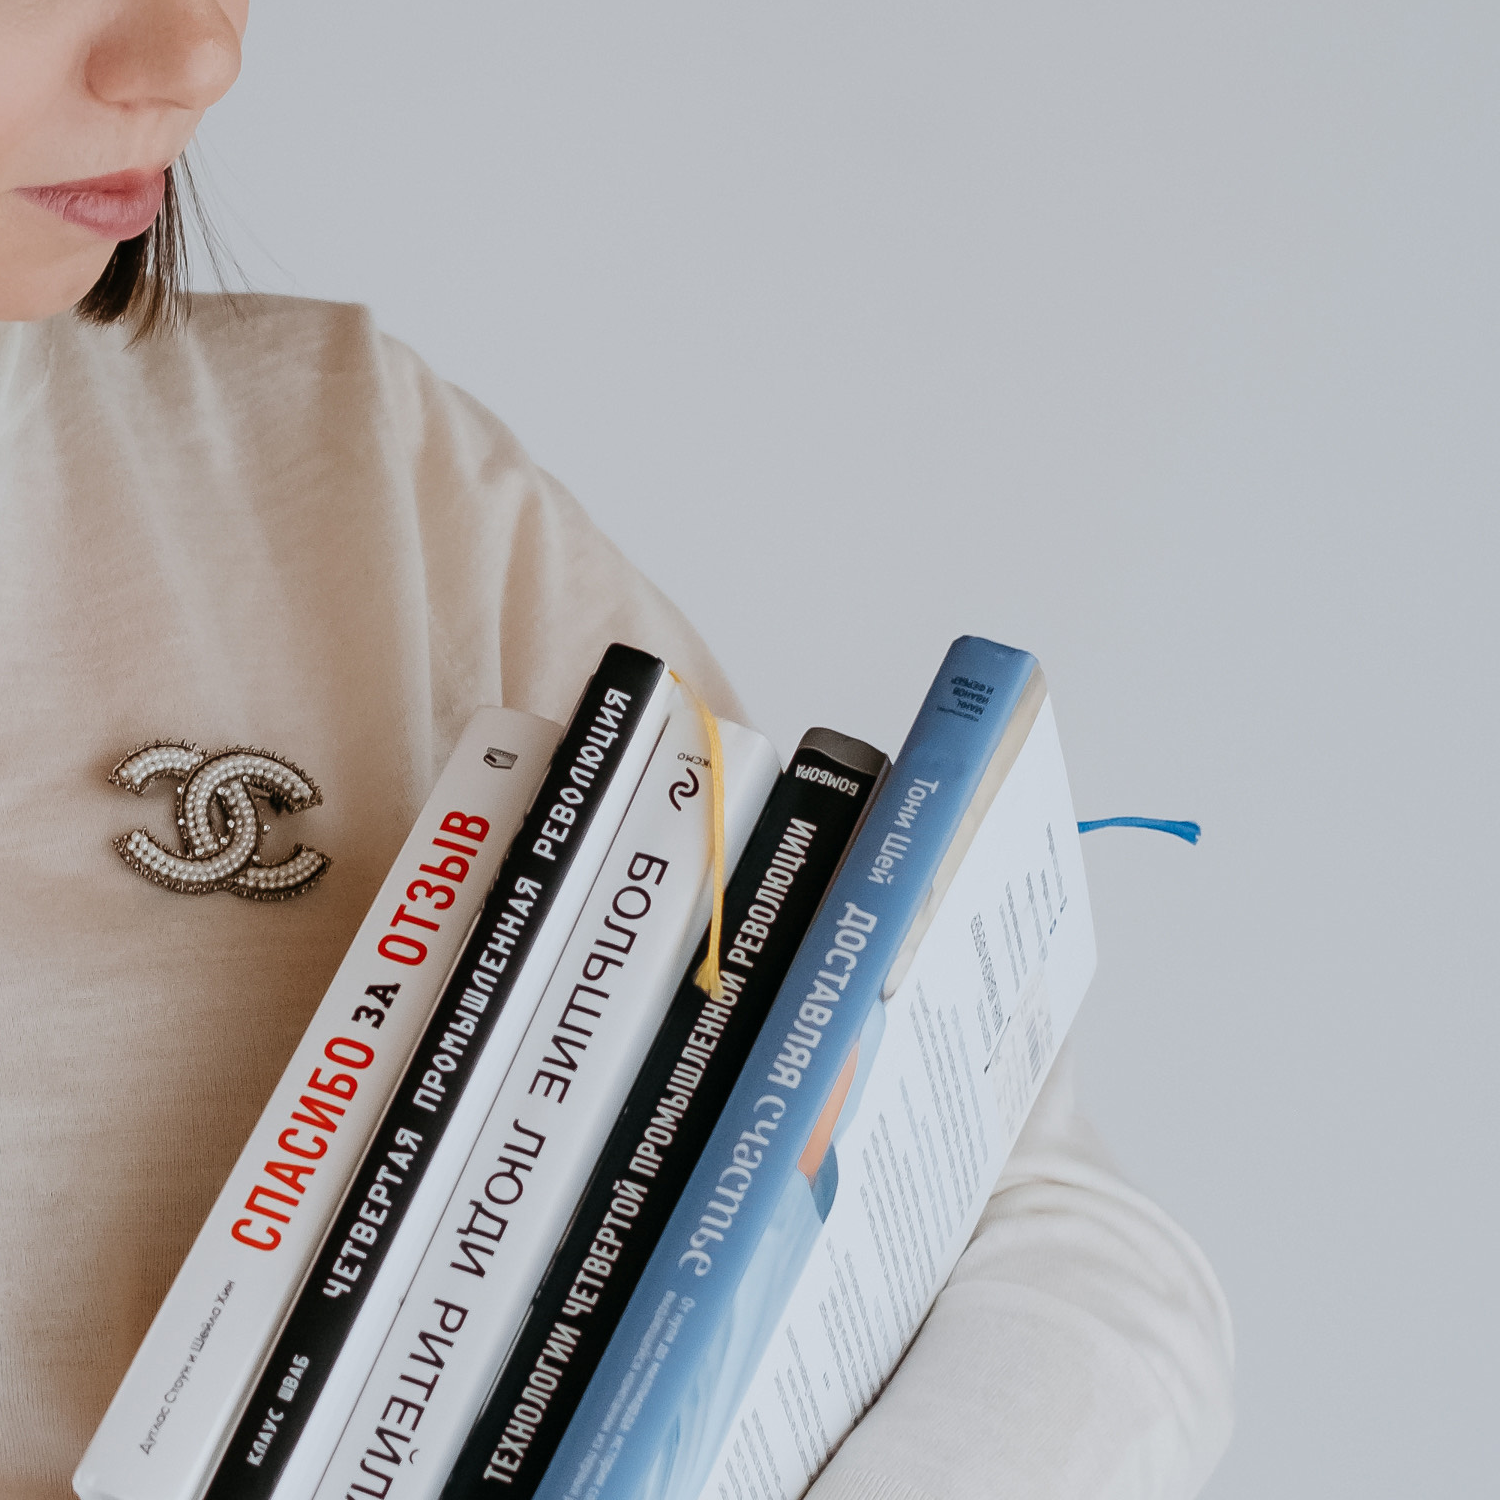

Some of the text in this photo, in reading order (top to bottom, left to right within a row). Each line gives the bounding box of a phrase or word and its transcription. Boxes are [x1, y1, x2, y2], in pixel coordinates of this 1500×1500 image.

[676, 751, 712, 769] КСМО
[795, 763, 860, 797] БОМБОРА
[867, 778, 940, 885] Тони Шей
[231, 811, 491, 1252] СПАСИБО ЗА ОТЗЫВ
[321, 687, 632, 1299] ЧЕТВЕРТАЯ ПРОМЫШЛЕННАЯ РЕВОЛЮЦИЯ
[528, 851, 670, 1105] БОЛЬШИЕ
[766, 901, 878, 1091] ДОСТАВЛЯЯ
[449, 1118, 547, 1279] ЛЮДИ
[483, 1321, 582, 1484] ТЕХНОЛОГИИ
[562, 1178, 649, 1318] ЧЕТВЕРТОЙ
[727, 817, 818, 968] РЕВОЛЮЦИИ
[139, 1405, 171, 1455] Дуглас
[164, 1364, 192, 1404] Стоун
[191, 1306, 222, 1352] Шейла
[214, 1279, 236, 1304] Хин
[246, 1353, 310, 1468] КЛАУС ШВАБ
